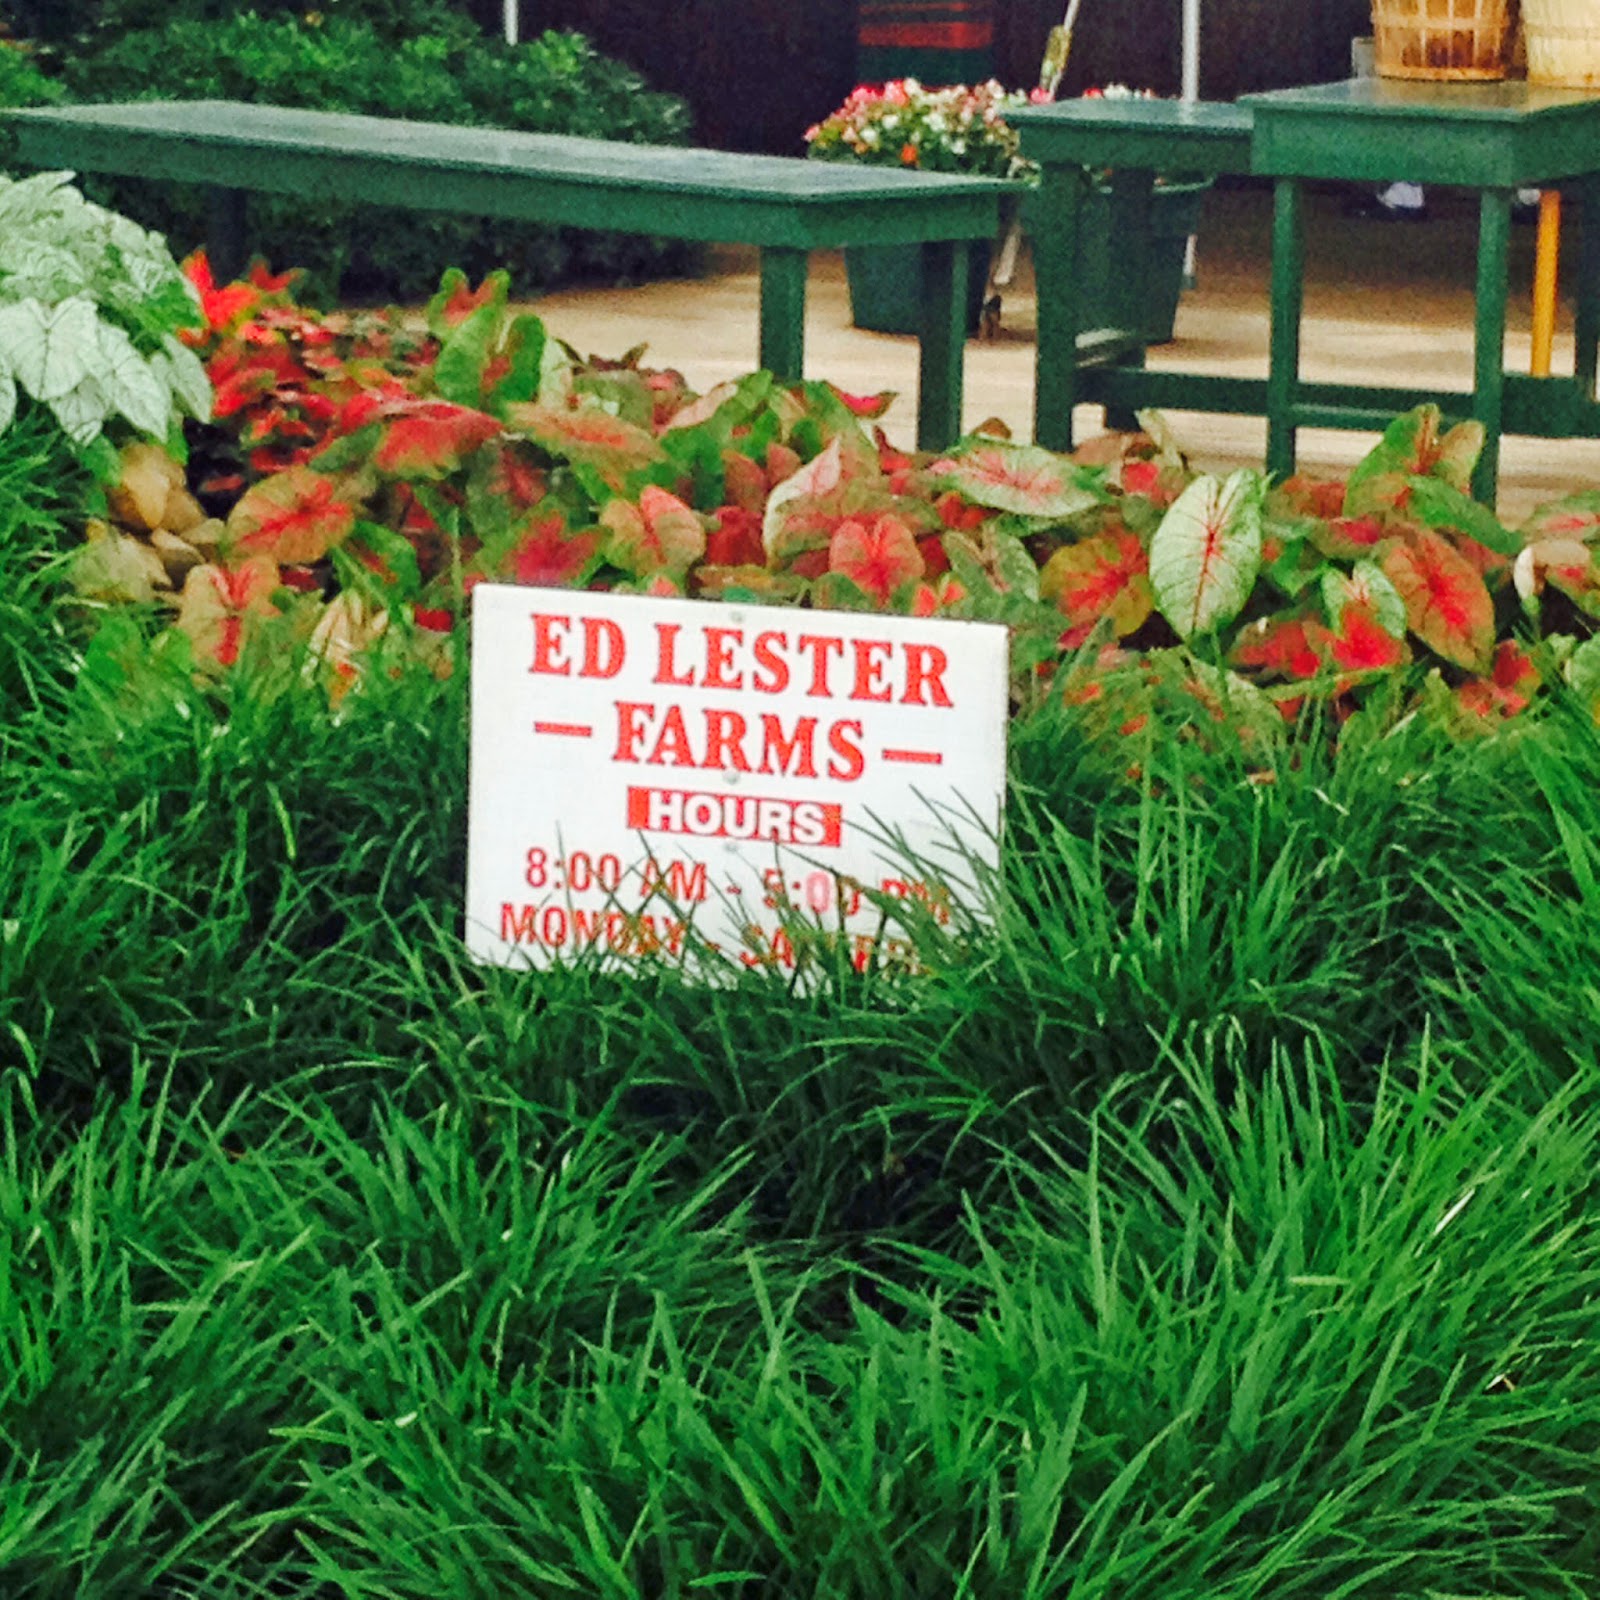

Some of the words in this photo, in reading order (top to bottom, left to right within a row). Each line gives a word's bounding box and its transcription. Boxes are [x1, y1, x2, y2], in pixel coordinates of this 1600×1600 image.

[529, 613, 626, 678] ED
[652, 622, 954, 708] LESTER
[612, 701, 864, 782] FARMS
[648, 790, 825, 842] HOURS
[526, 847, 621, 893] 8:00
[640, 858, 707, 902] AM
